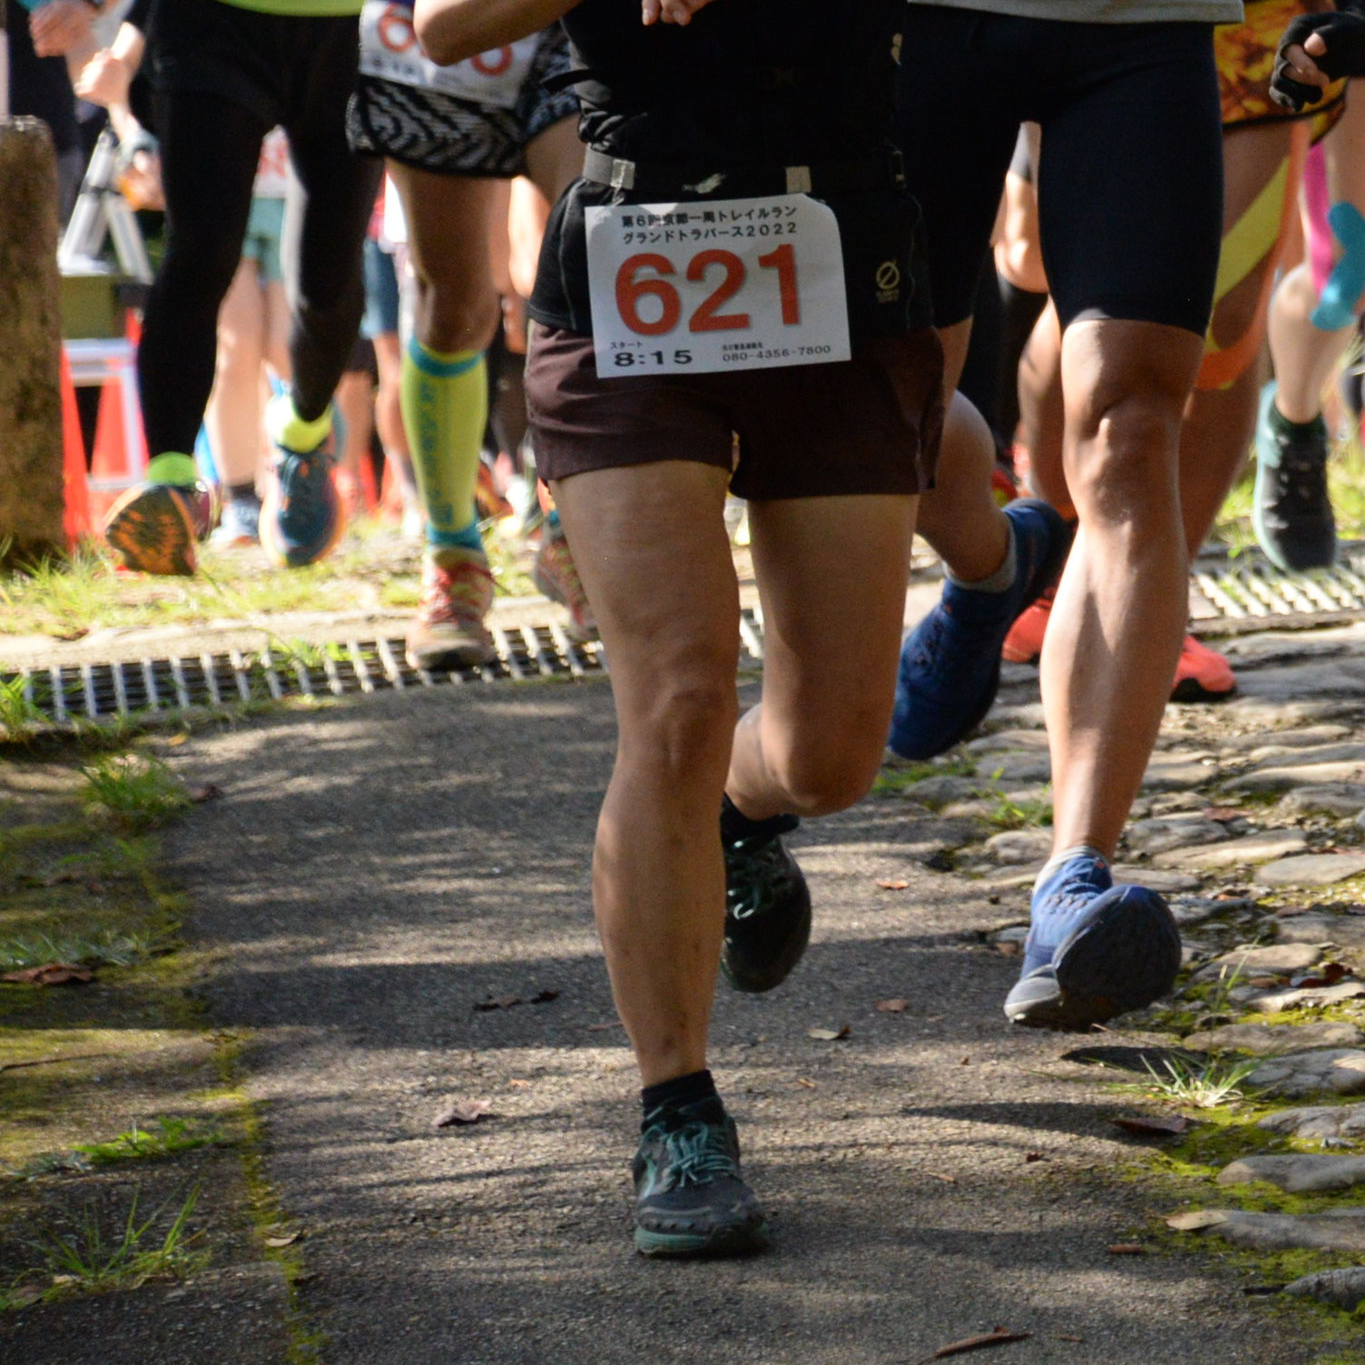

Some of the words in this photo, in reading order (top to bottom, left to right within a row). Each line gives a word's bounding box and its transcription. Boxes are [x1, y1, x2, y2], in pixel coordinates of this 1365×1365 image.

[622, 221, 797, 245] グランドトラバース2022
[615, 243, 802, 336] 621
[609, 340, 644, 350] スタート
[722, 344, 832, 363] 080-4356-7800
[614, 349, 694, 368] 8:15
